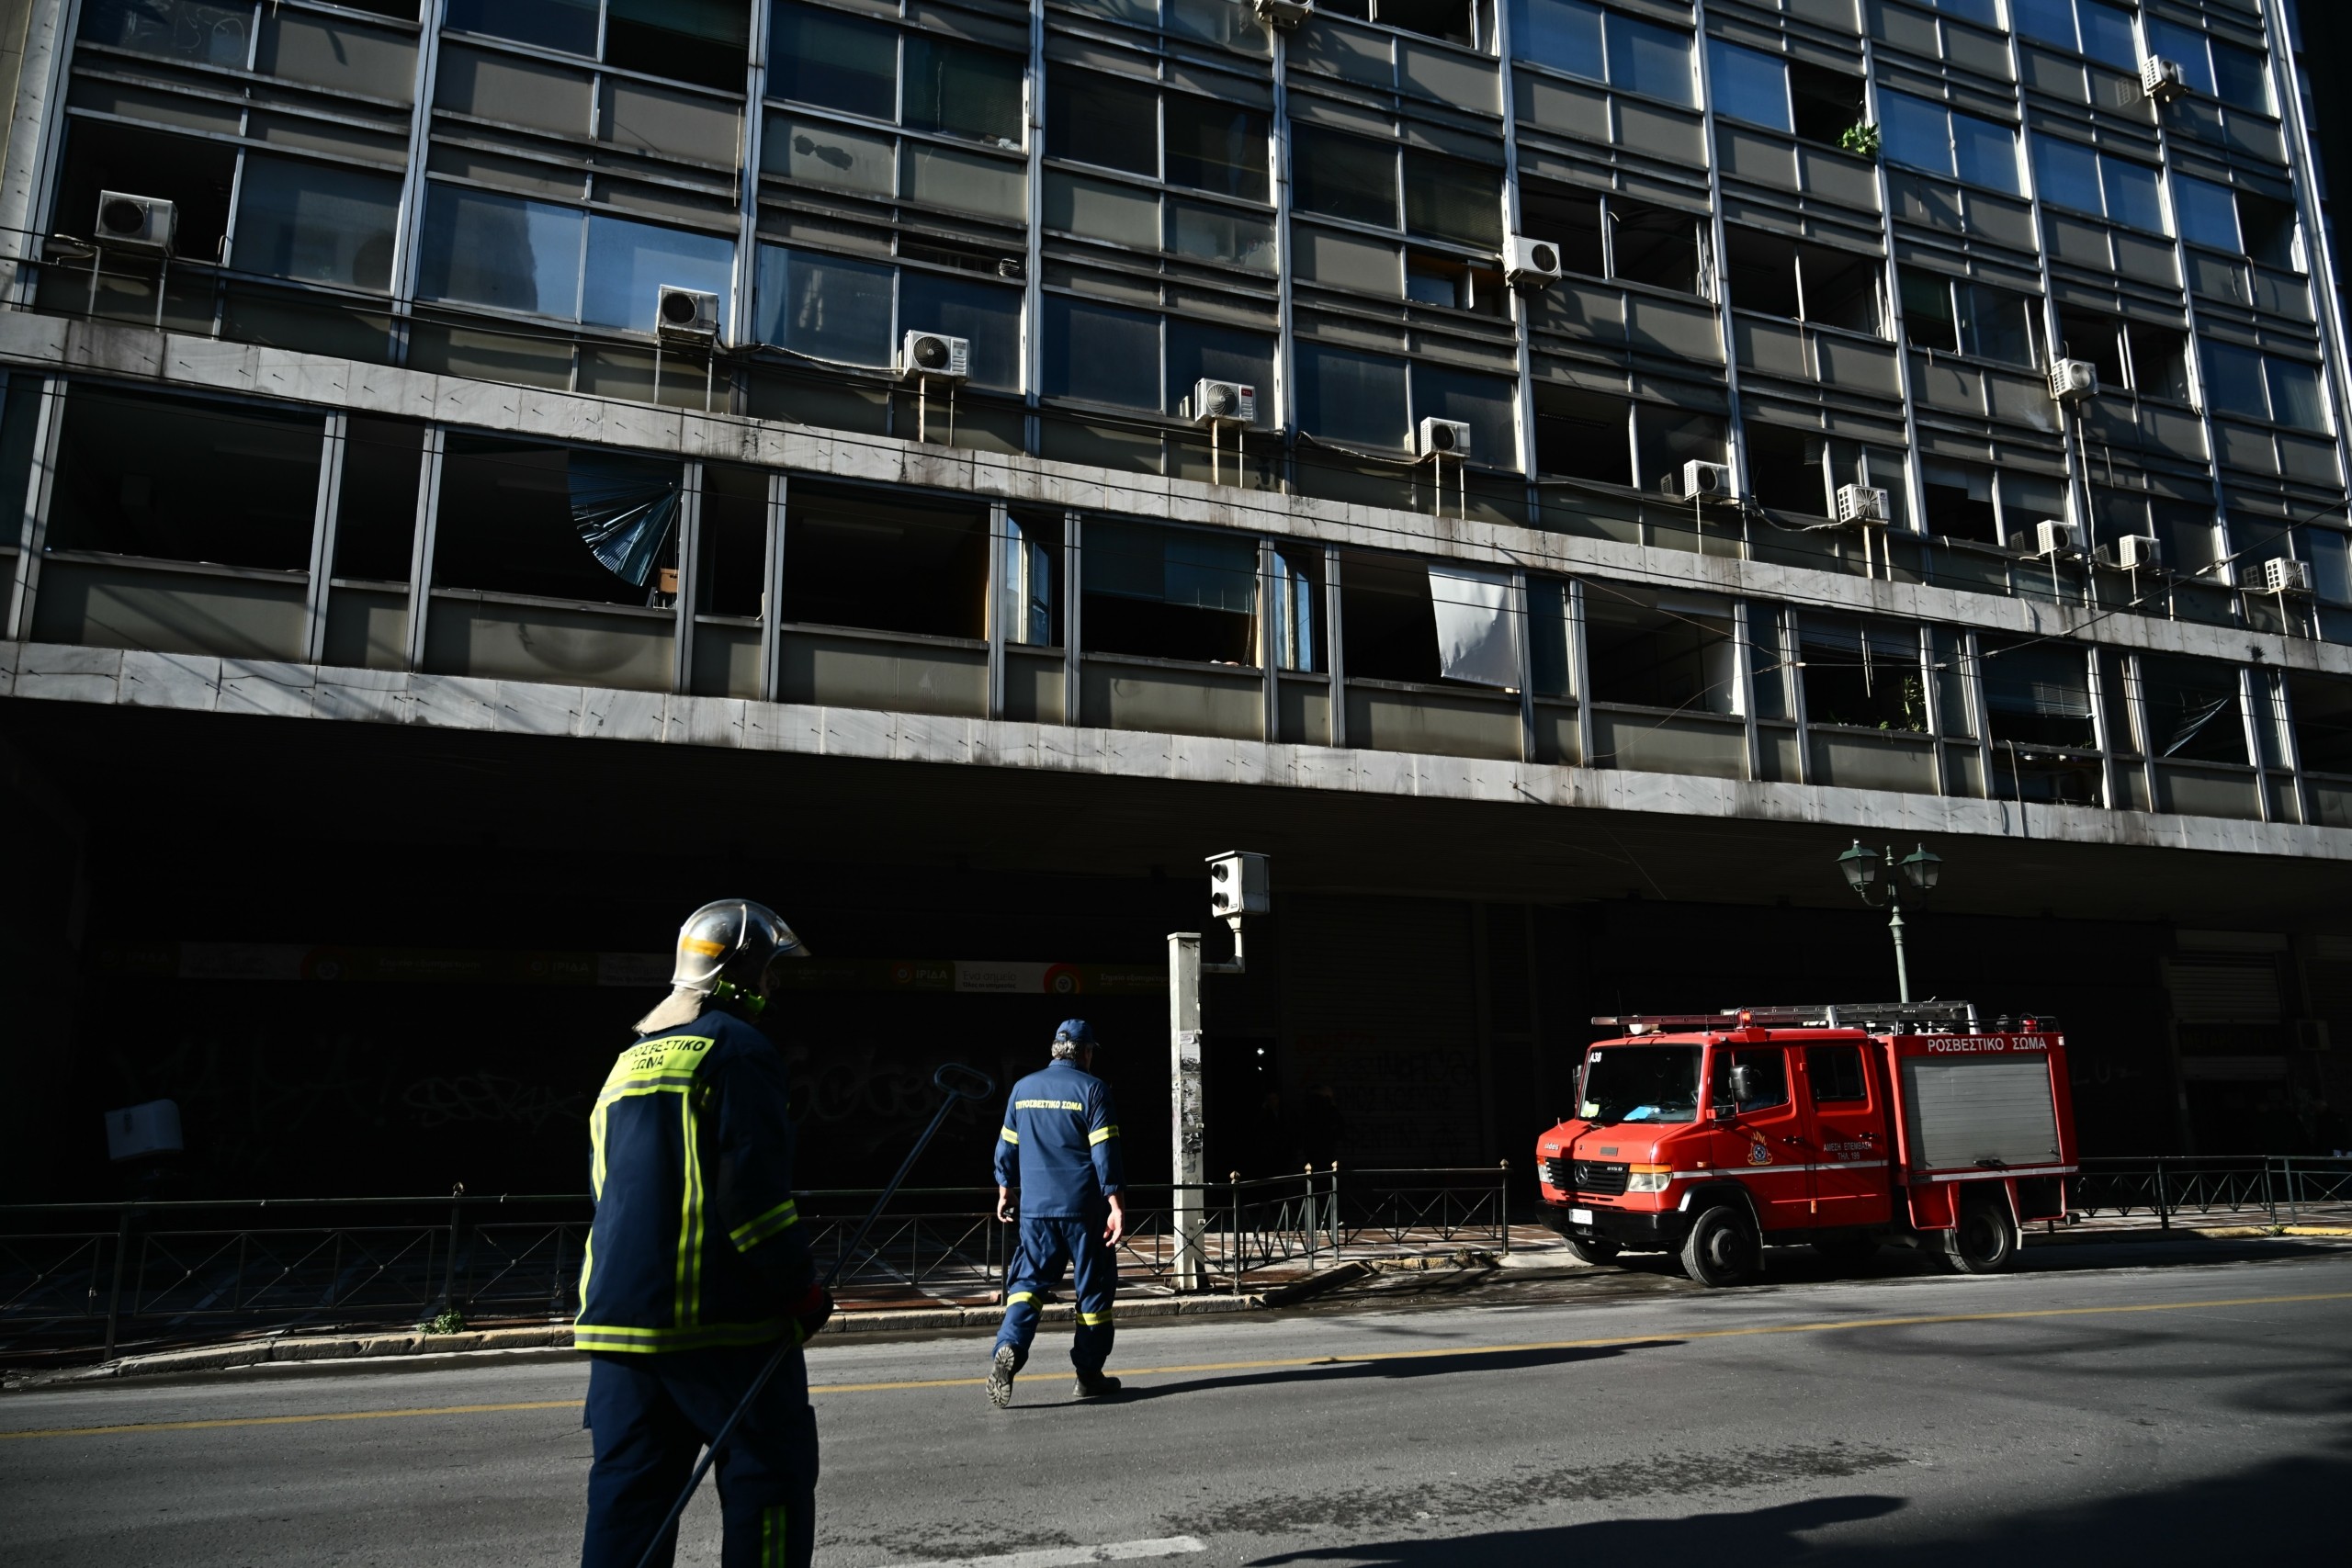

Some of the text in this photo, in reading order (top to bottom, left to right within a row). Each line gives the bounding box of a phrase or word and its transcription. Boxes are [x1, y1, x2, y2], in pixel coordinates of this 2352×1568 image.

[1928, 1036, 2048, 1053] ΡΟΣΒΕΣΤΙΚΟ ΣΩΜΑ
[1061, 1100, 1082, 1111] ΣΩΜΑ
